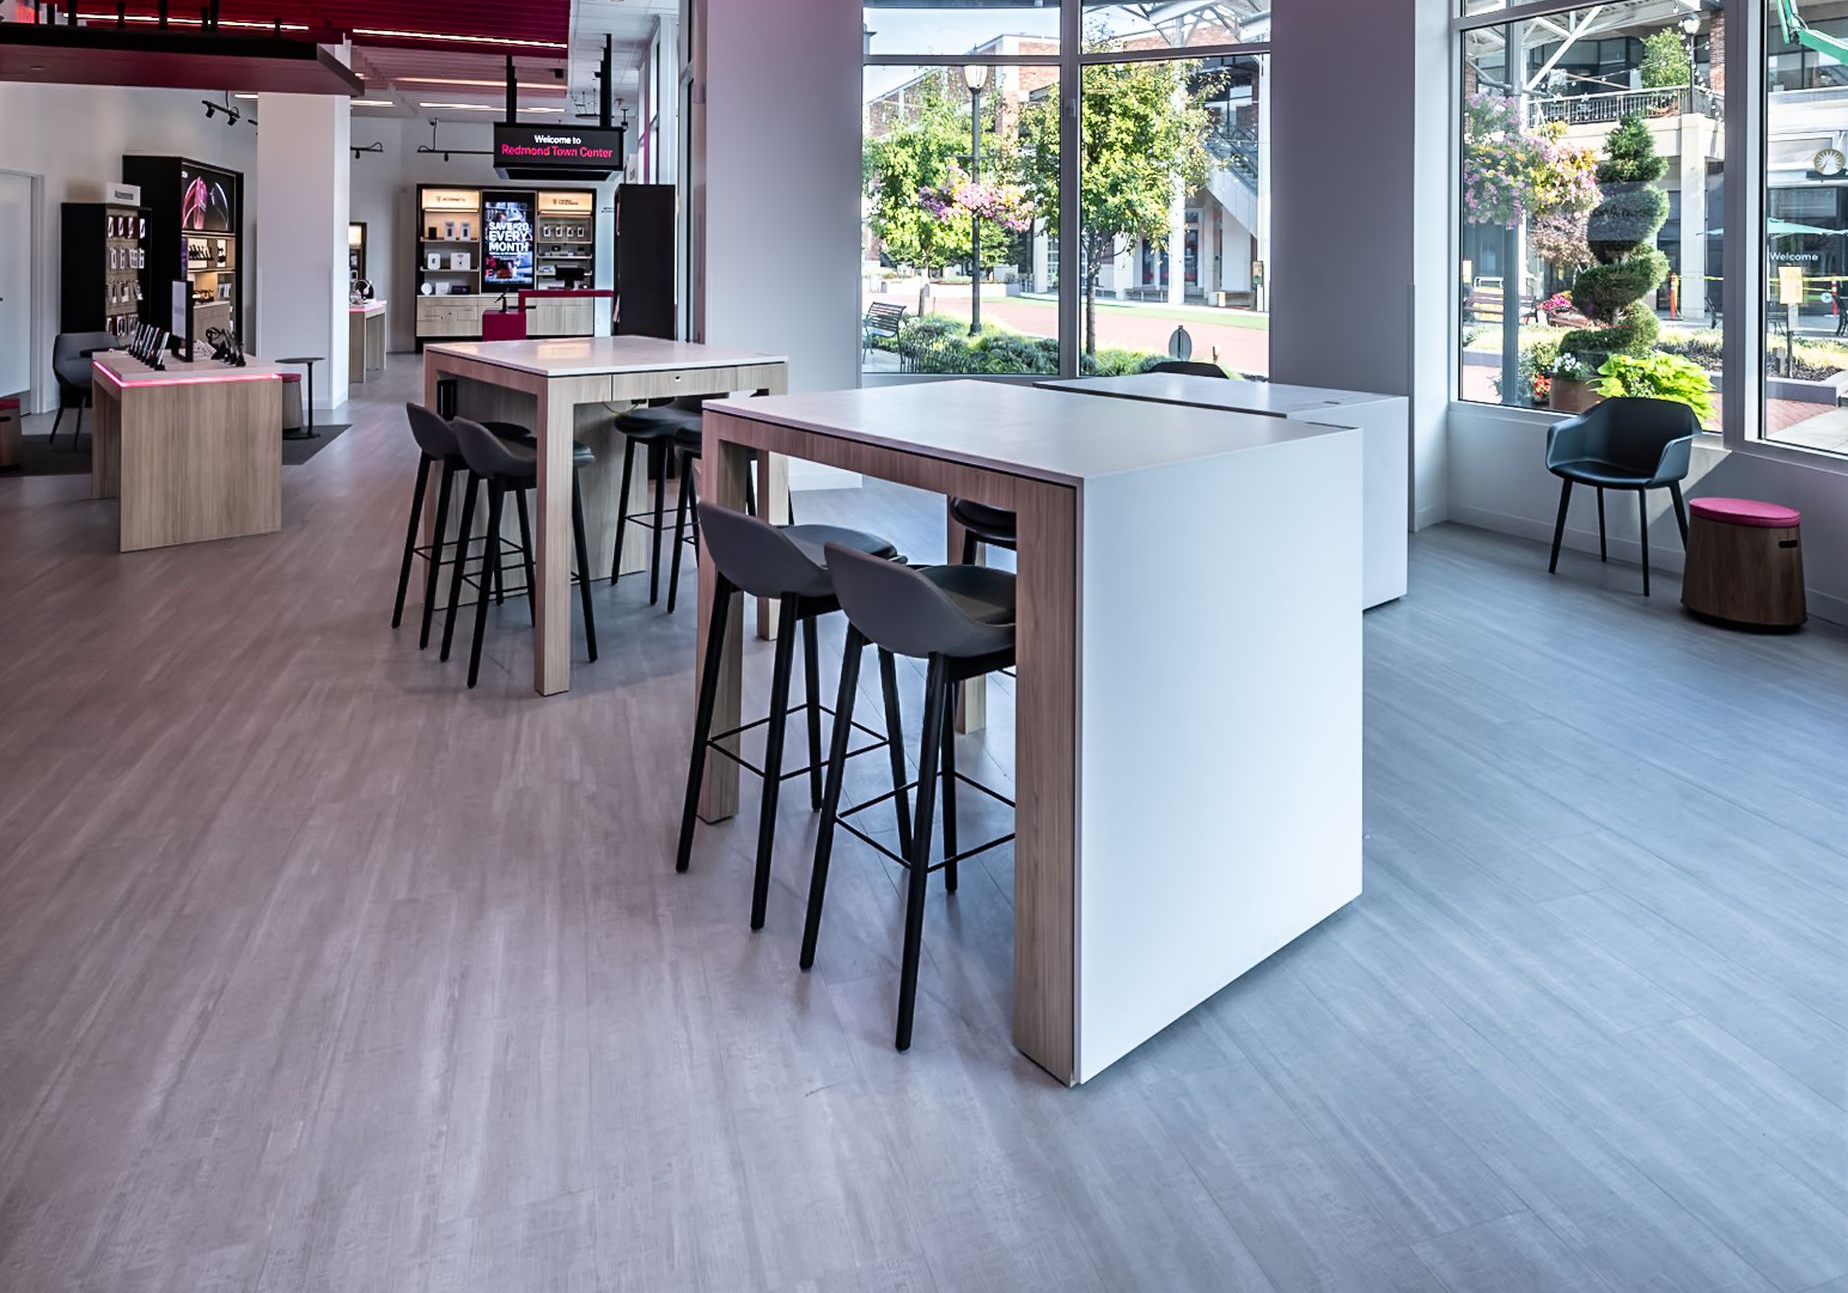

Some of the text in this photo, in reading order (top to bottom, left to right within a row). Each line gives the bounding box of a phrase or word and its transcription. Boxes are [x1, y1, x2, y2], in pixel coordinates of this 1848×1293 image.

[534, 134, 581, 144] Welcome to
[501, 144, 613, 158] Redmond Town Center
[489, 221, 512, 231] SAVE
[489, 231, 530, 241] EVERY
[489, 241, 529, 252] MONTH
[1770, 252, 1819, 261] Welcome
